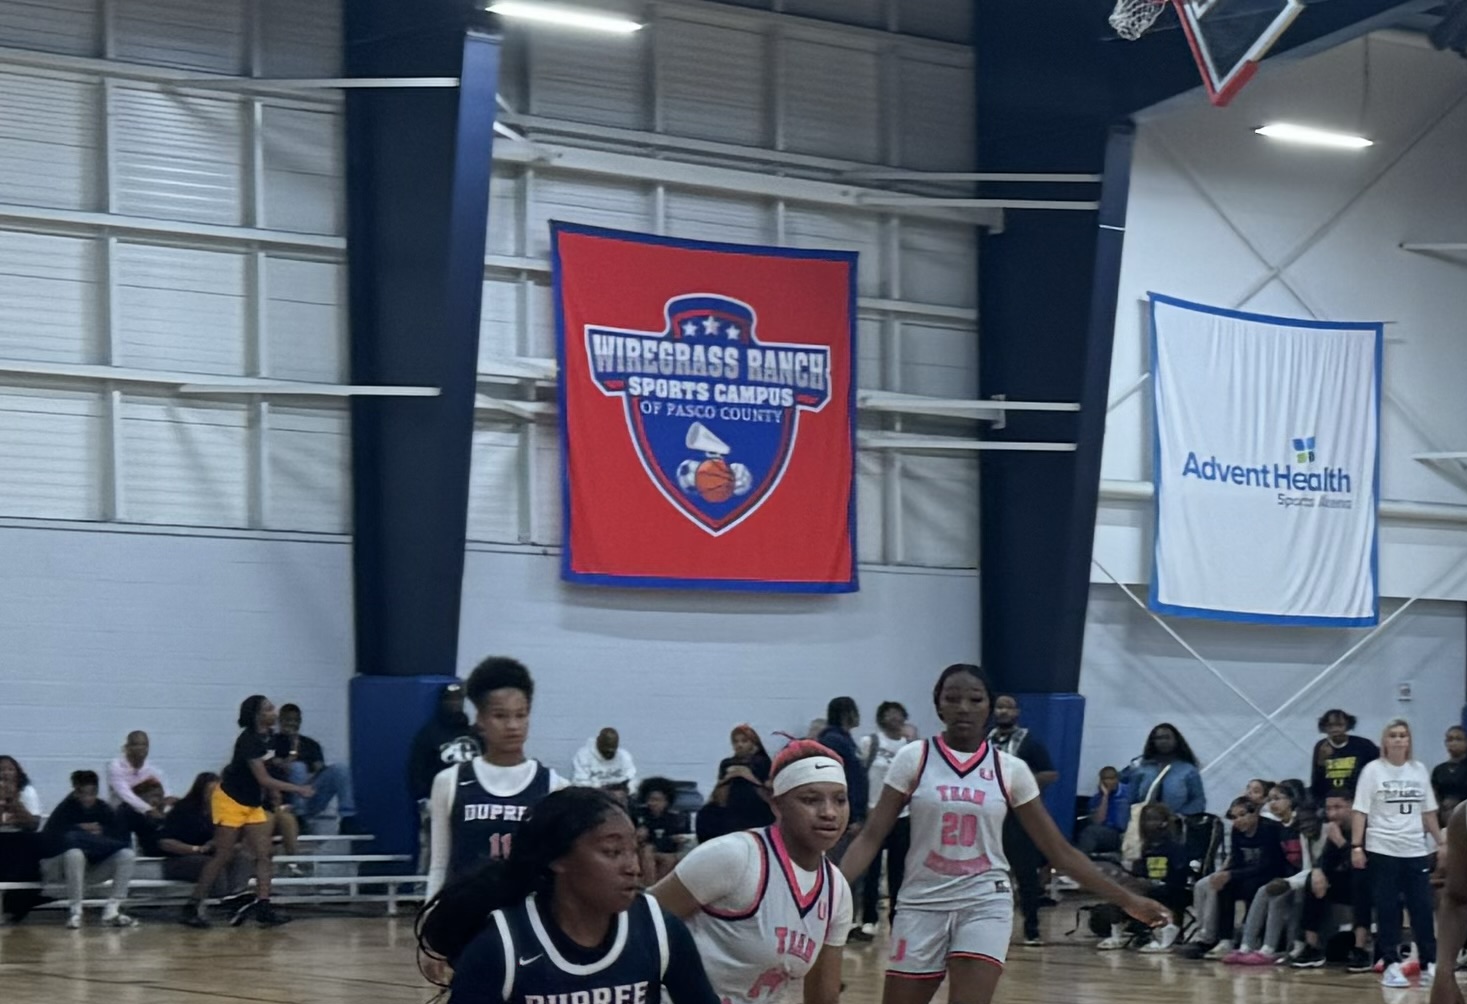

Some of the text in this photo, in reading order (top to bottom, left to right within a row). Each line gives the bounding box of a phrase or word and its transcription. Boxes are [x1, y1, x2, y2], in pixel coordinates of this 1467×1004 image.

[592, 334, 826, 391] WIREGRASS RANCH
[628, 376, 795, 407] SPORTS CAMPUS
[640, 400, 784, 424] OF PASCO COUNTY
[936, 784, 986, 806] TEAM
[941, 811, 978, 847] 20
